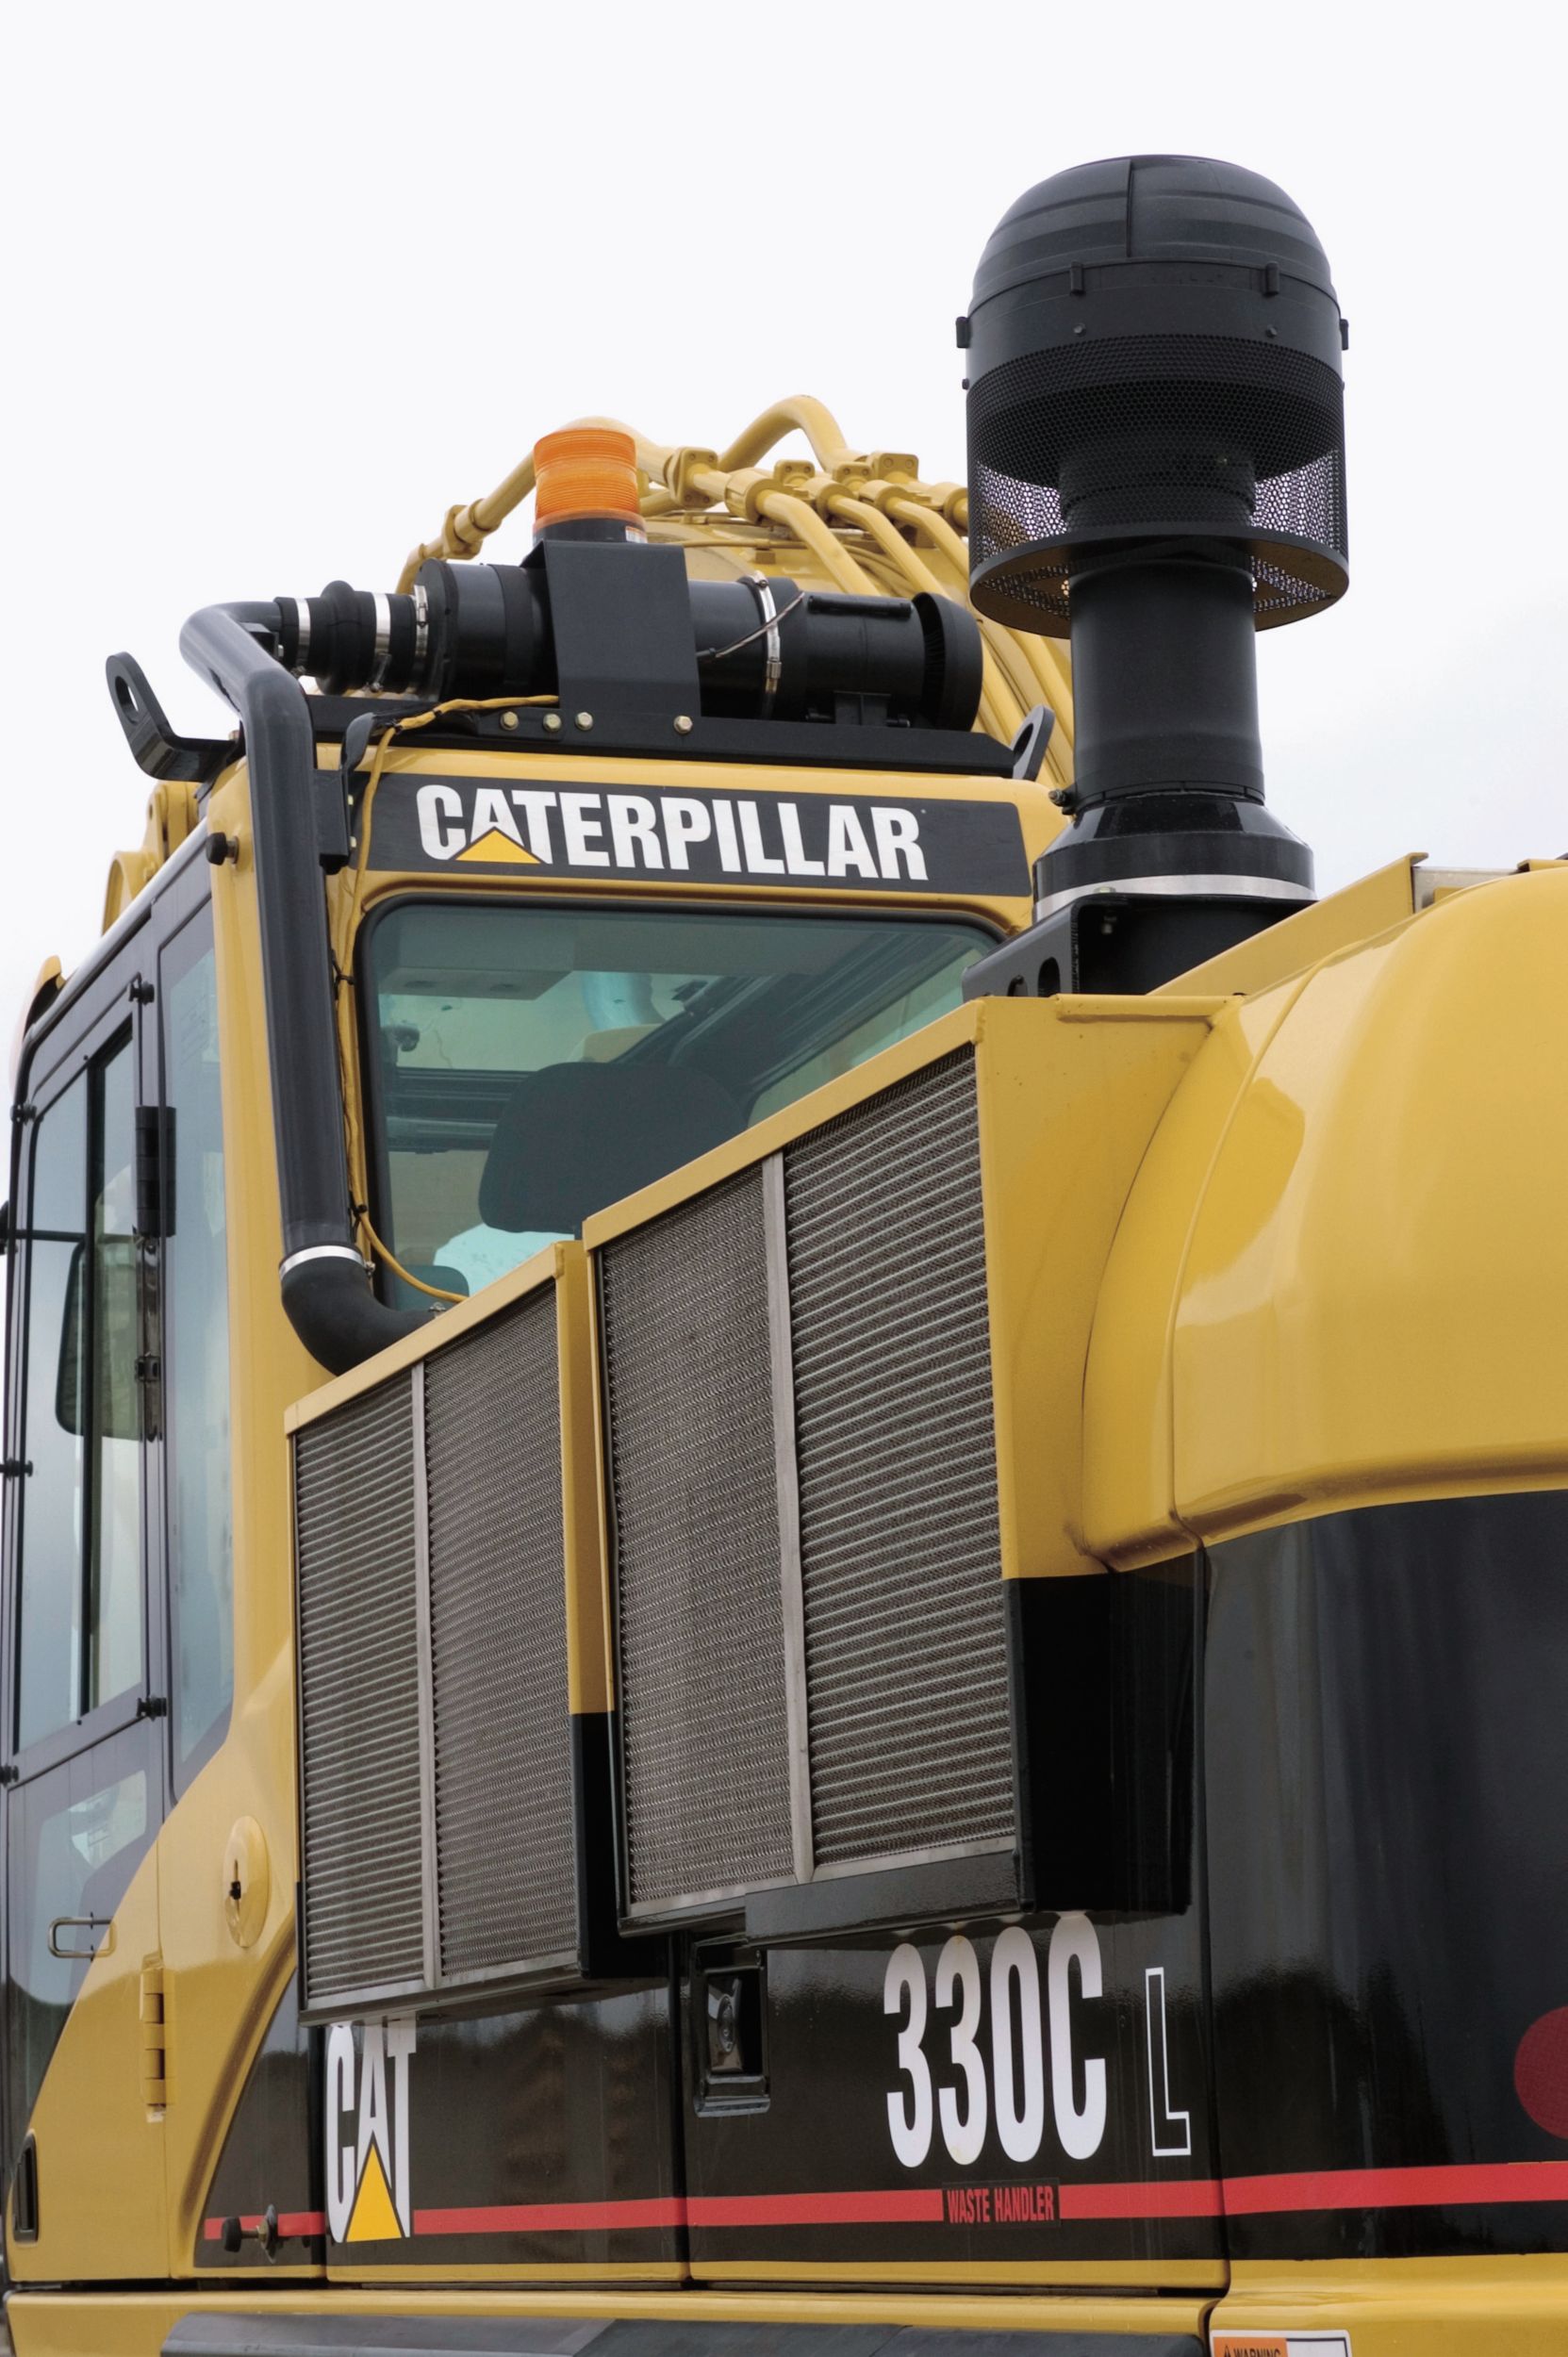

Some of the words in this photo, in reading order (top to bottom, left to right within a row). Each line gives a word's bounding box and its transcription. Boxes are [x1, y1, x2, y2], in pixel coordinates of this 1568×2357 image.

[416, 784, 929, 882] CATERPILLAR
[883, 1911, 1107, 2168] 330C
[1145, 1967, 1192, 2156] L
[326, 2012, 417, 2244] CAT
[947, 2188, 990, 2223] WASTE
[994, 2185, 1054, 2222] HANDLER
